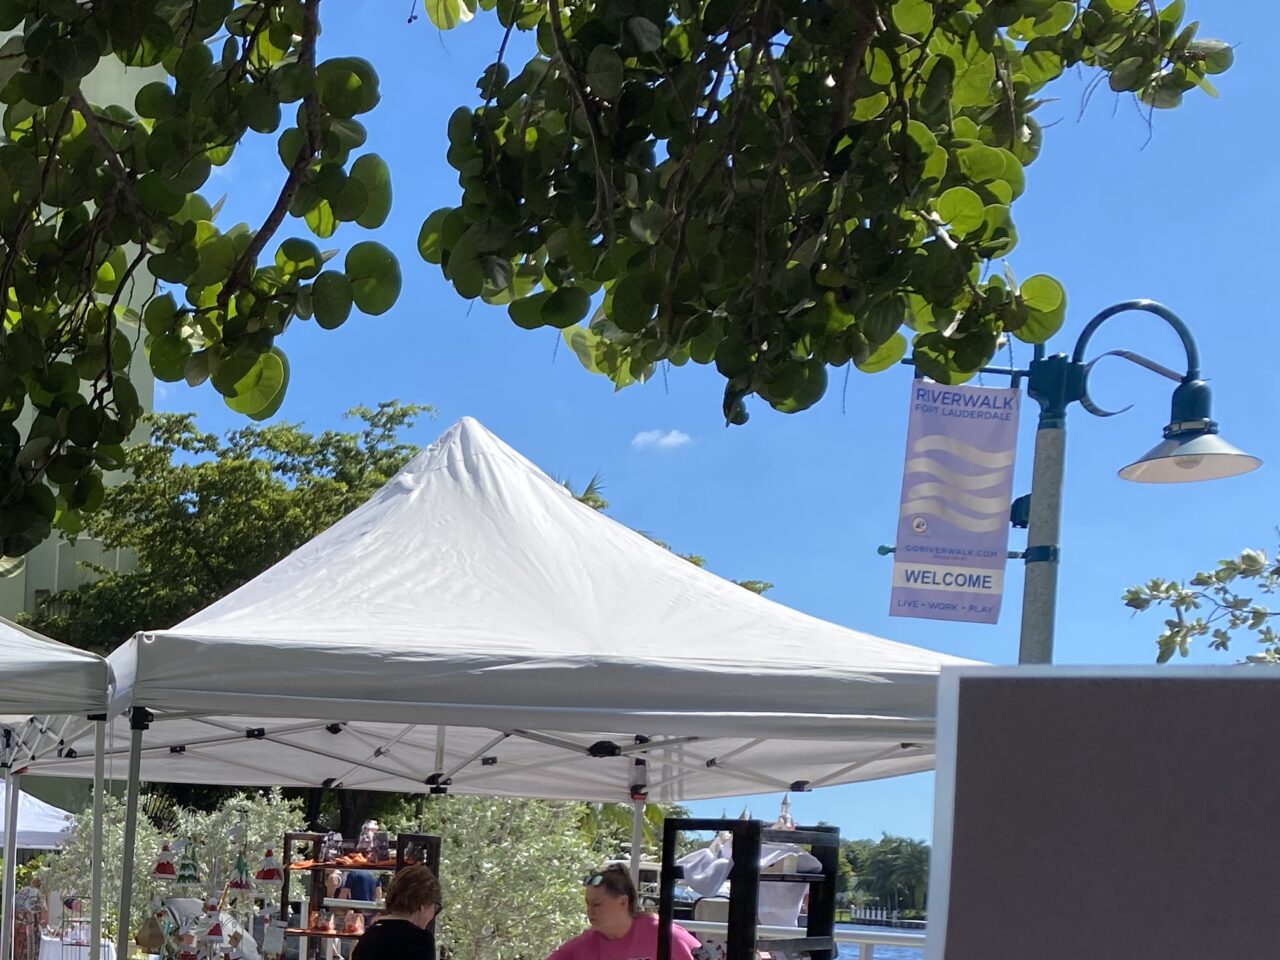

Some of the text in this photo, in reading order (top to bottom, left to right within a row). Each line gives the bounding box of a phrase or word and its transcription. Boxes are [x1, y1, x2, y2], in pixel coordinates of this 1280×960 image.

[916, 388, 1014, 410] RIVERWALK
[915, 404, 1013, 421] FORT LAUDERDALE
[904, 569, 993, 589] WELCOME
[897, 600, 995, 614] LIVE WORK PLAY
